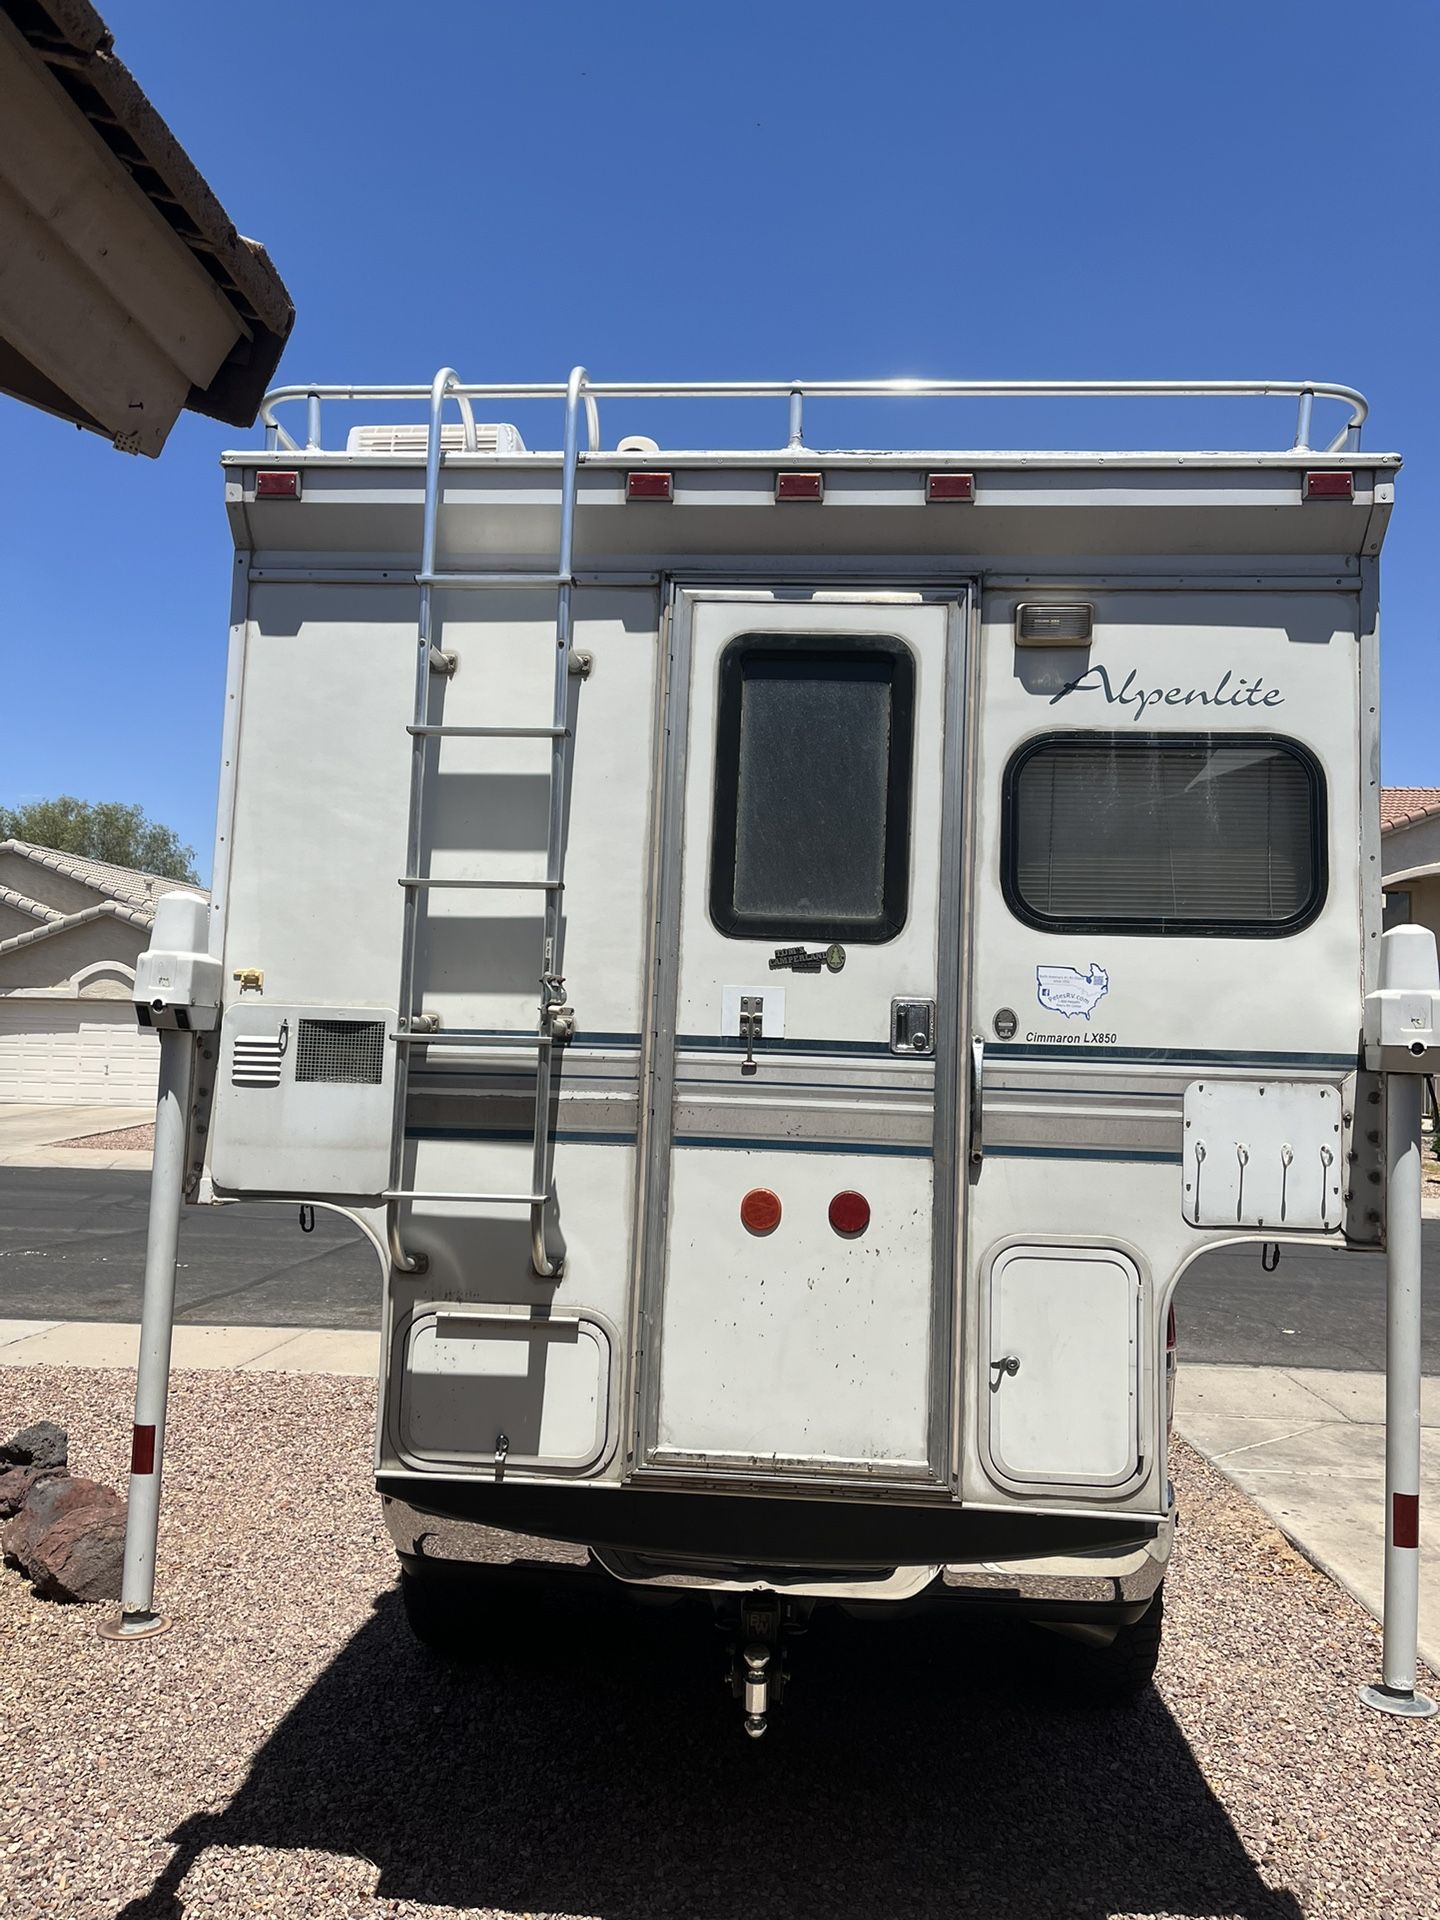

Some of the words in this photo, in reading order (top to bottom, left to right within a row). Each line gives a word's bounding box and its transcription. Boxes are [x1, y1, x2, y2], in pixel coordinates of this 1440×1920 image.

[1049, 664, 1285, 721] Alpenlite
[1025, 1032, 1080, 1043] Cimmaron
[1083, 1032, 1117, 1043] LX850
